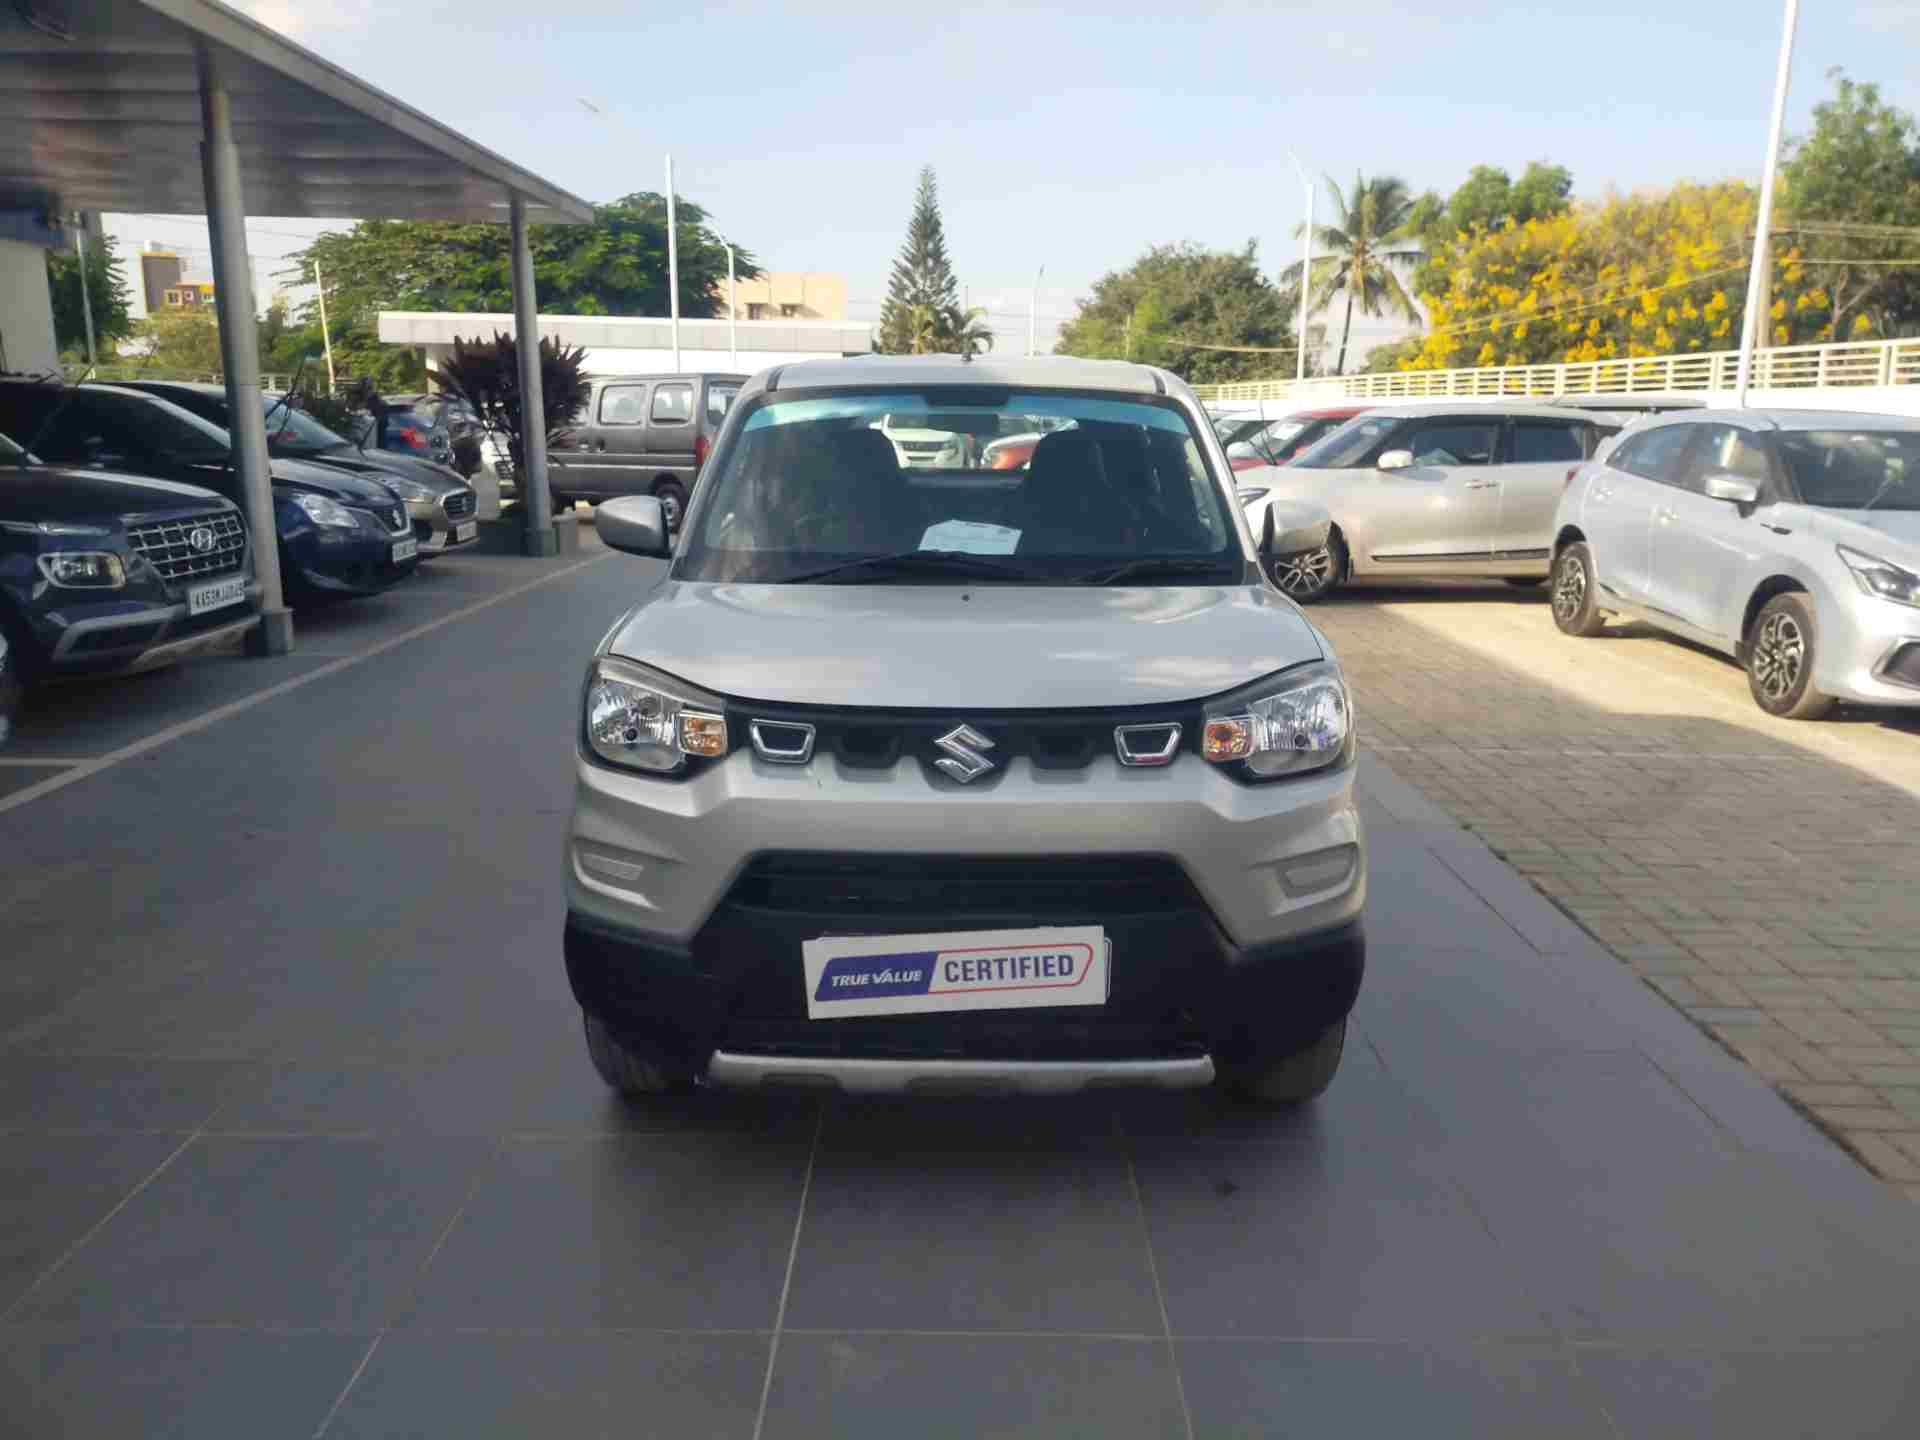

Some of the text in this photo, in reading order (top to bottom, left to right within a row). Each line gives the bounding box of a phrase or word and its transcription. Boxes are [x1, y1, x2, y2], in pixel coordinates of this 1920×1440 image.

[831, 955, 1074, 987] TRUE VALUE CERTIFIED
